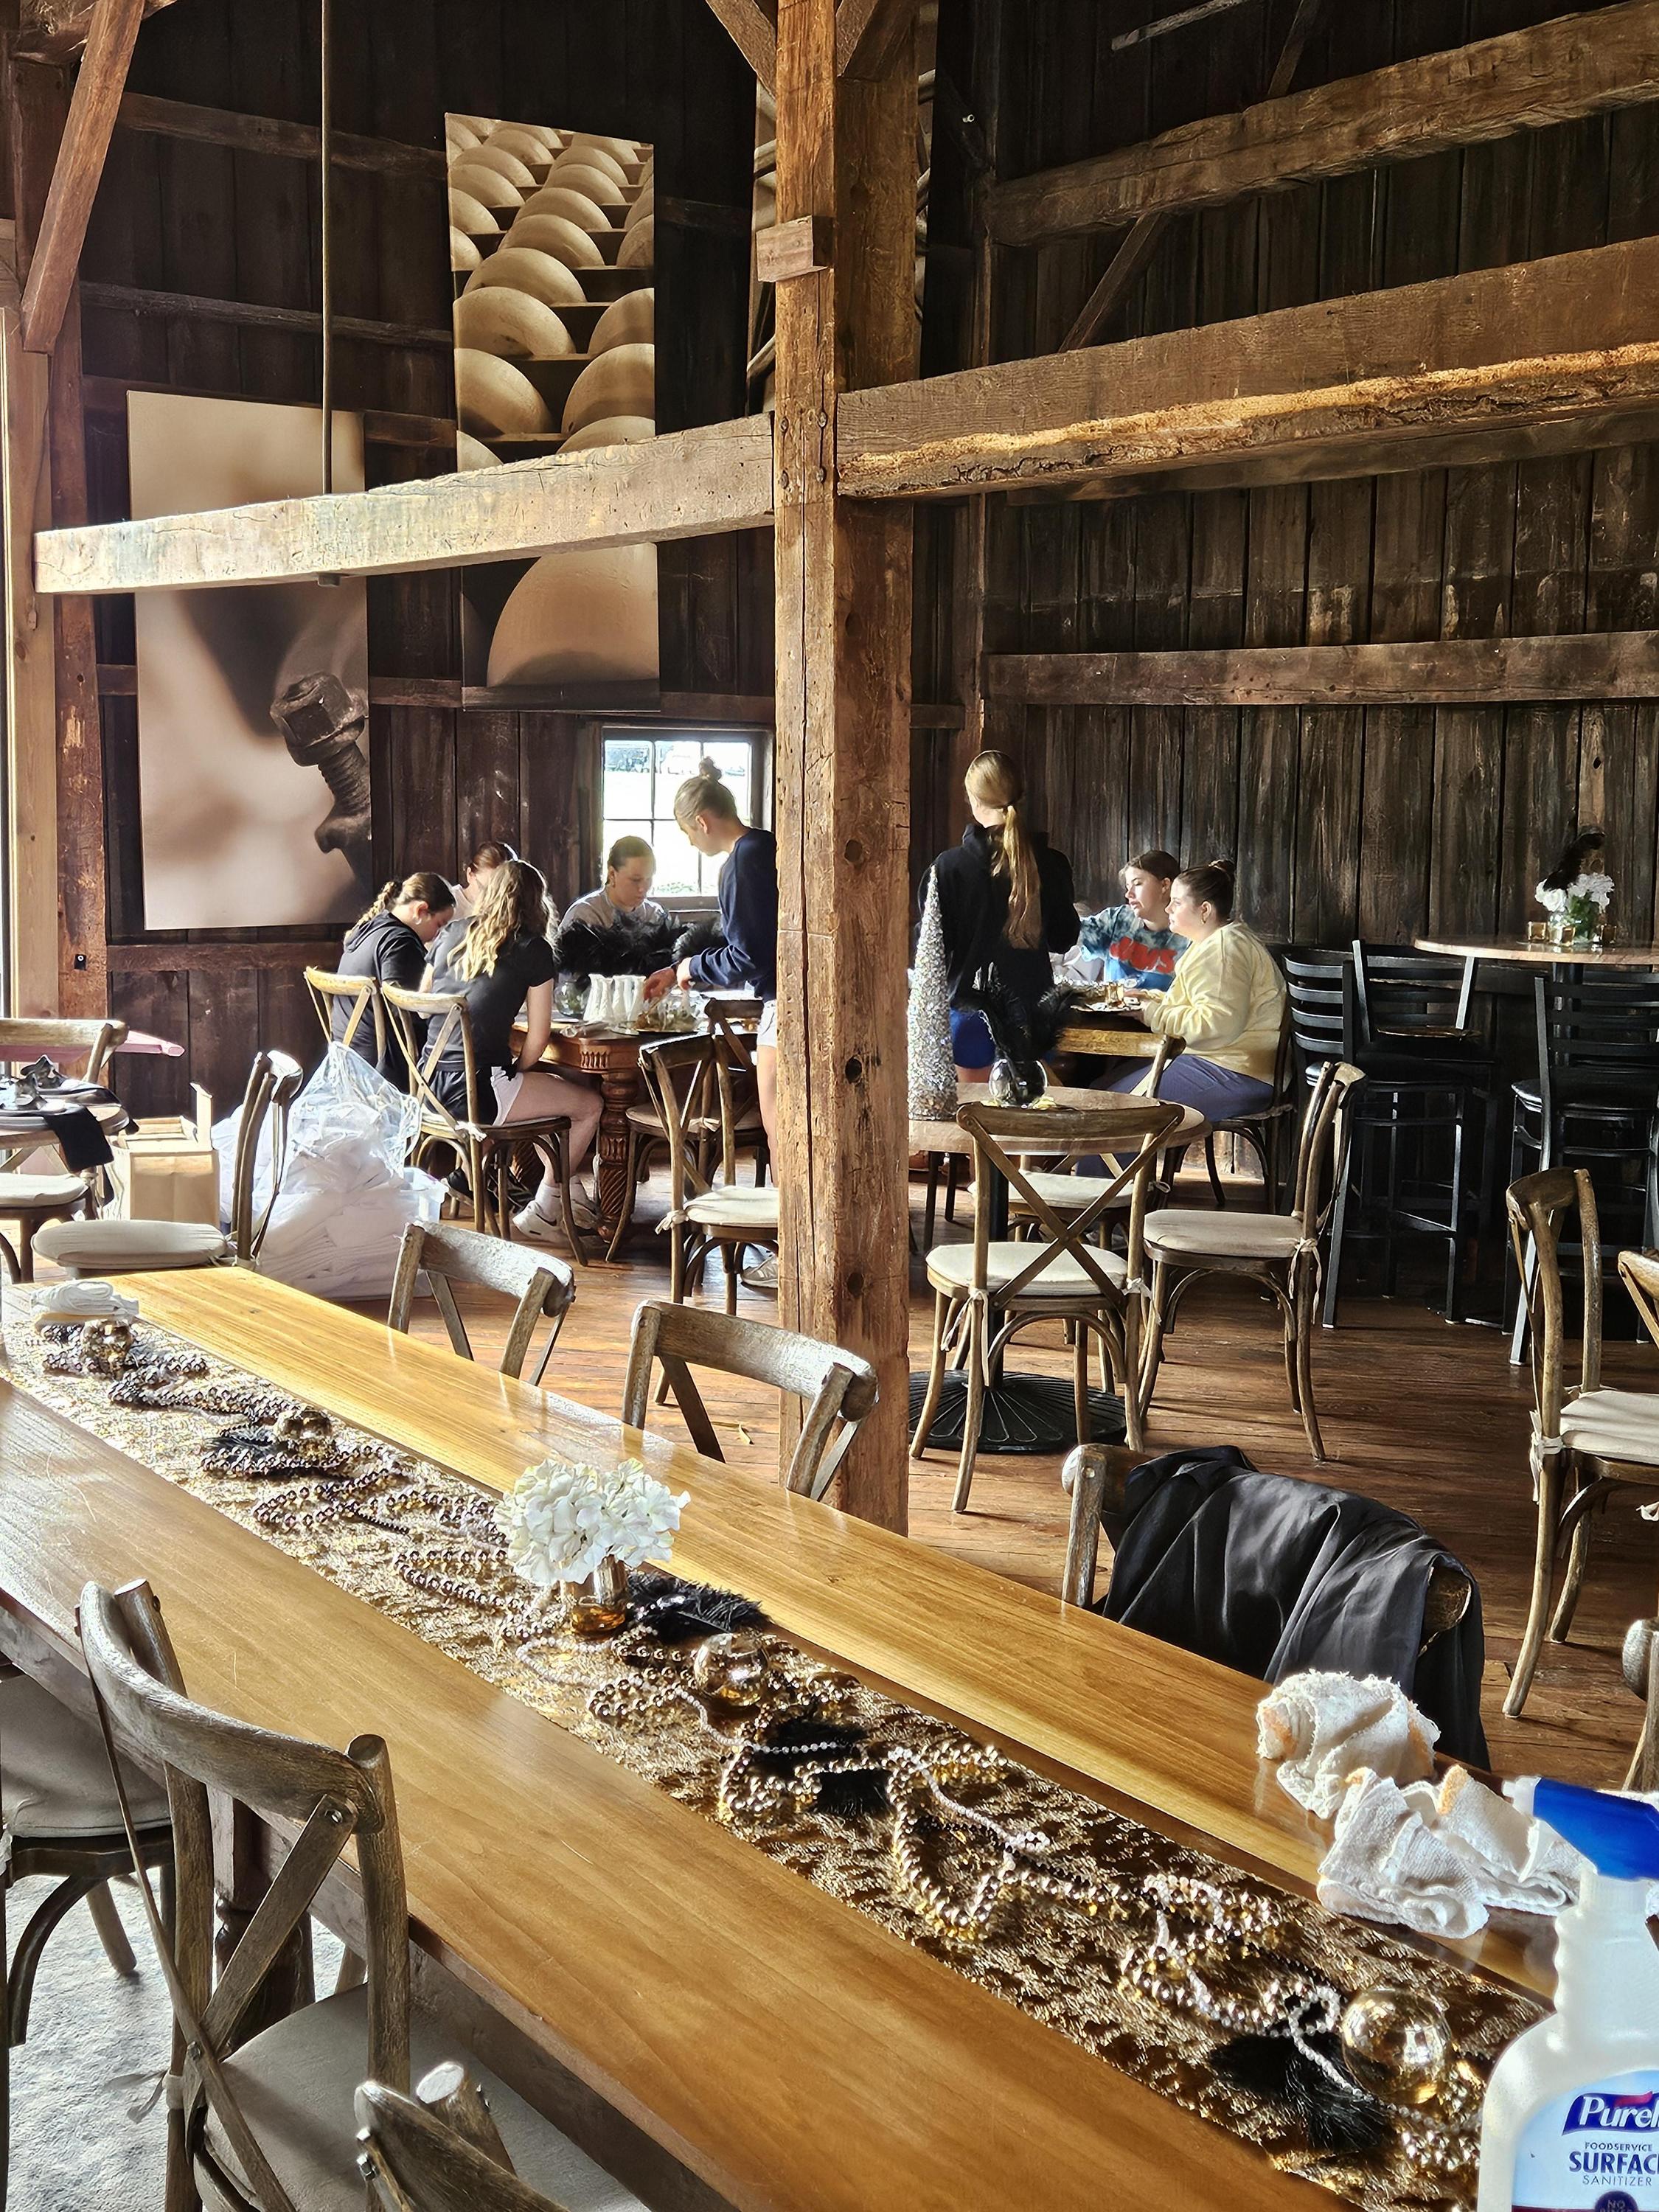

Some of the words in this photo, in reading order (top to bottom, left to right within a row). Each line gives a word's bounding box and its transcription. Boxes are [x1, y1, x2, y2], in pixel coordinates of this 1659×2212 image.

[1579, 2096, 1659, 2128] Purel
[1585, 2141, 1652, 2152] FOODSERVICE
[1569, 2151, 1659, 2175] SURFAC
[1582, 2174, 1652, 2187] SANITIZER
[1607, 2199, 1626, 2208] NO
